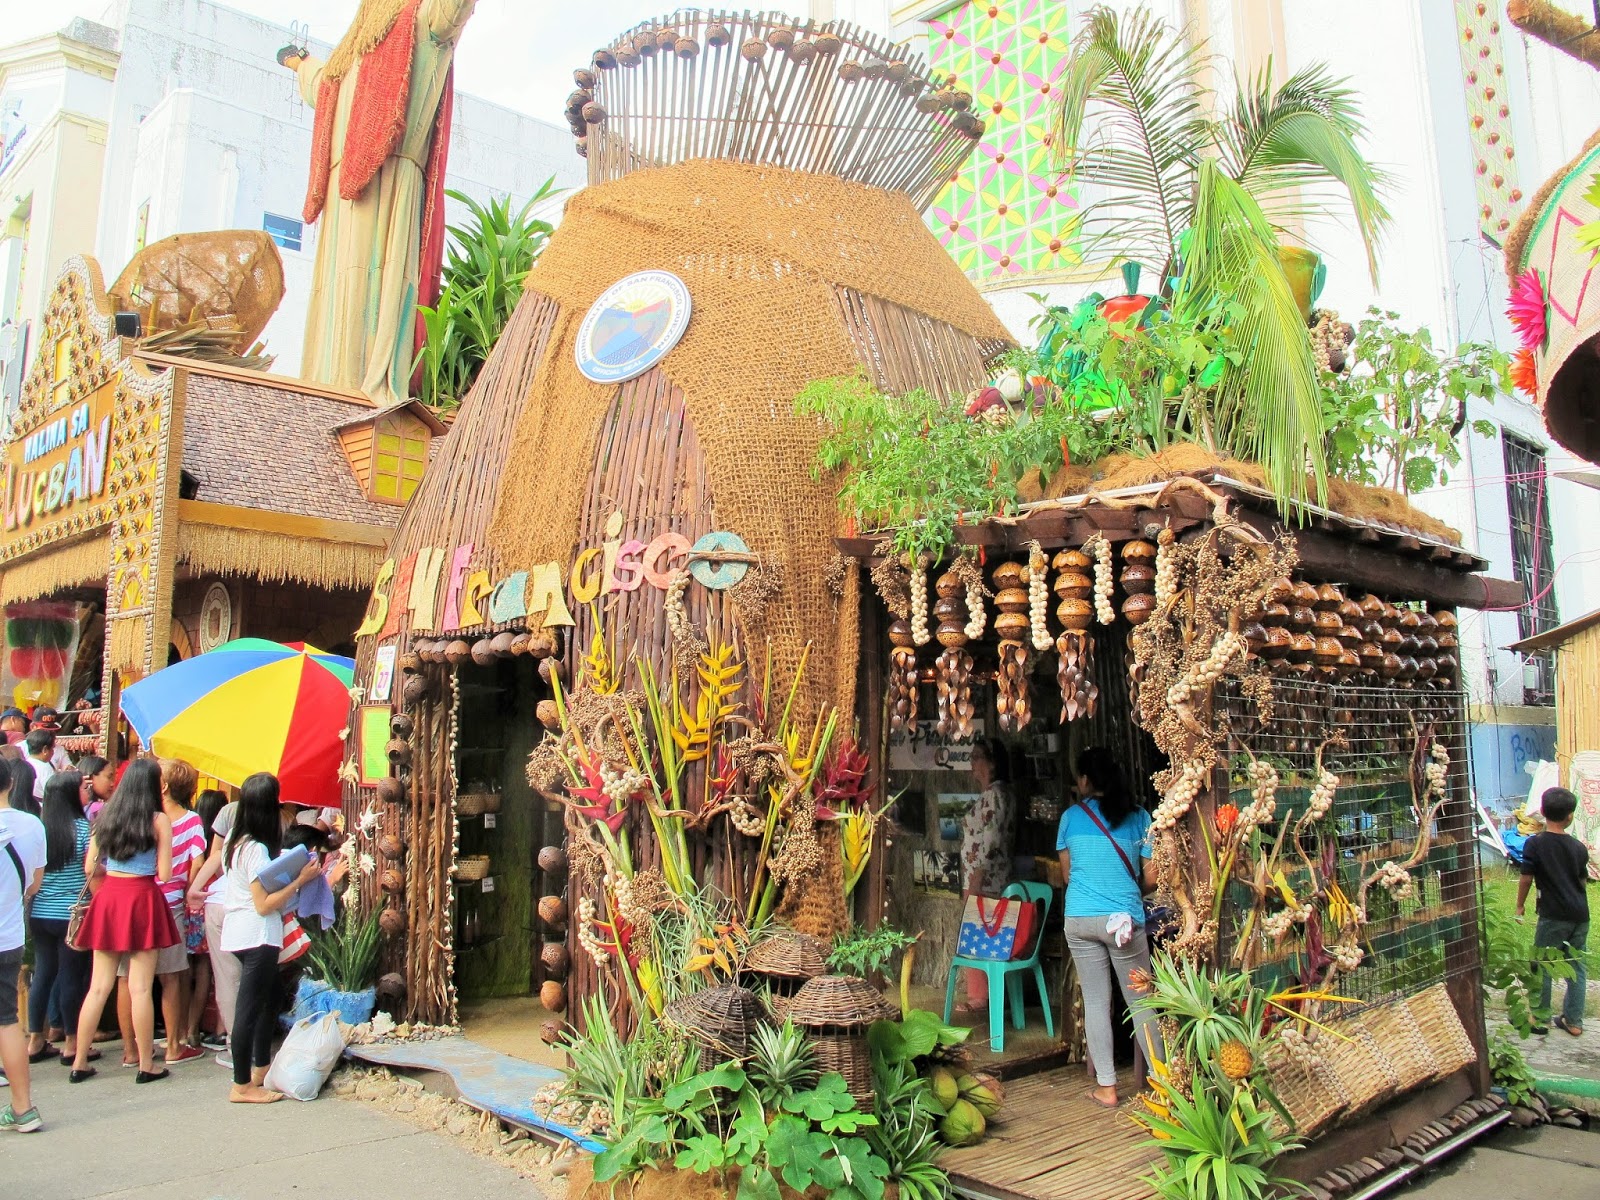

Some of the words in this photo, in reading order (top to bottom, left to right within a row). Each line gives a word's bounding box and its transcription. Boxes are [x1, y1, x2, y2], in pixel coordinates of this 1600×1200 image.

[626, 276, 649, 287] SAN
[656, 309, 682, 350] QUEZON
[71, 403, 90, 438] SA
[4, 414, 110, 531] LUCBAN
